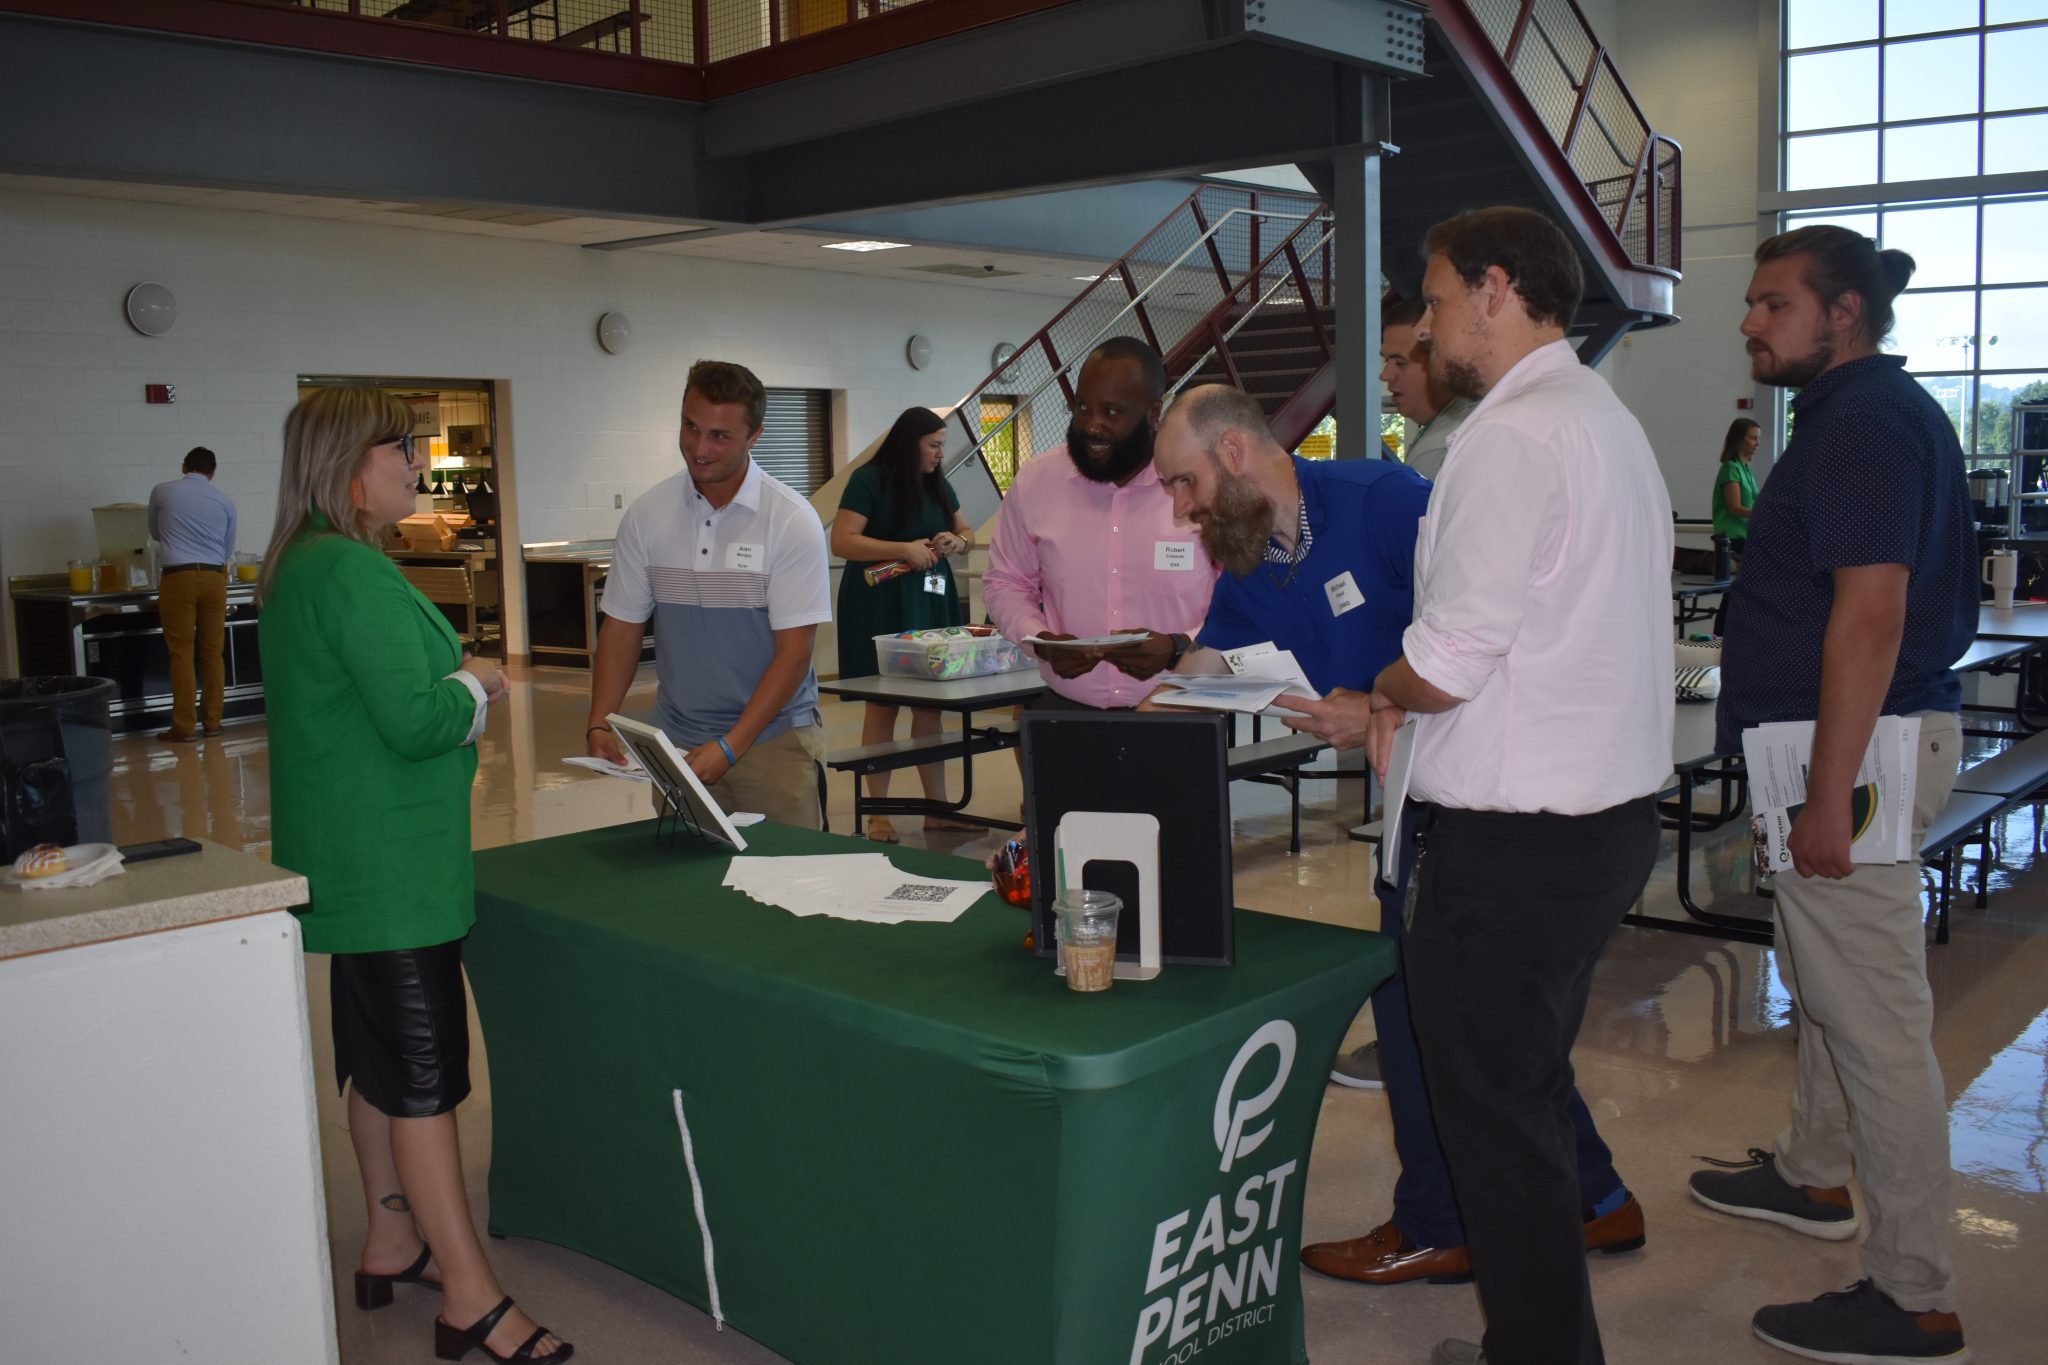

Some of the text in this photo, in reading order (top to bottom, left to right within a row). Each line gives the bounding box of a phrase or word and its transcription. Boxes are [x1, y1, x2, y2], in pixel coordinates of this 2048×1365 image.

[1776, 815, 1784, 833] PENN
[1144, 1158, 1297, 1296] EAST
[1129, 1237, 1283, 1365] PENN
[1207, 1304, 1276, 1346] DISTRICT
